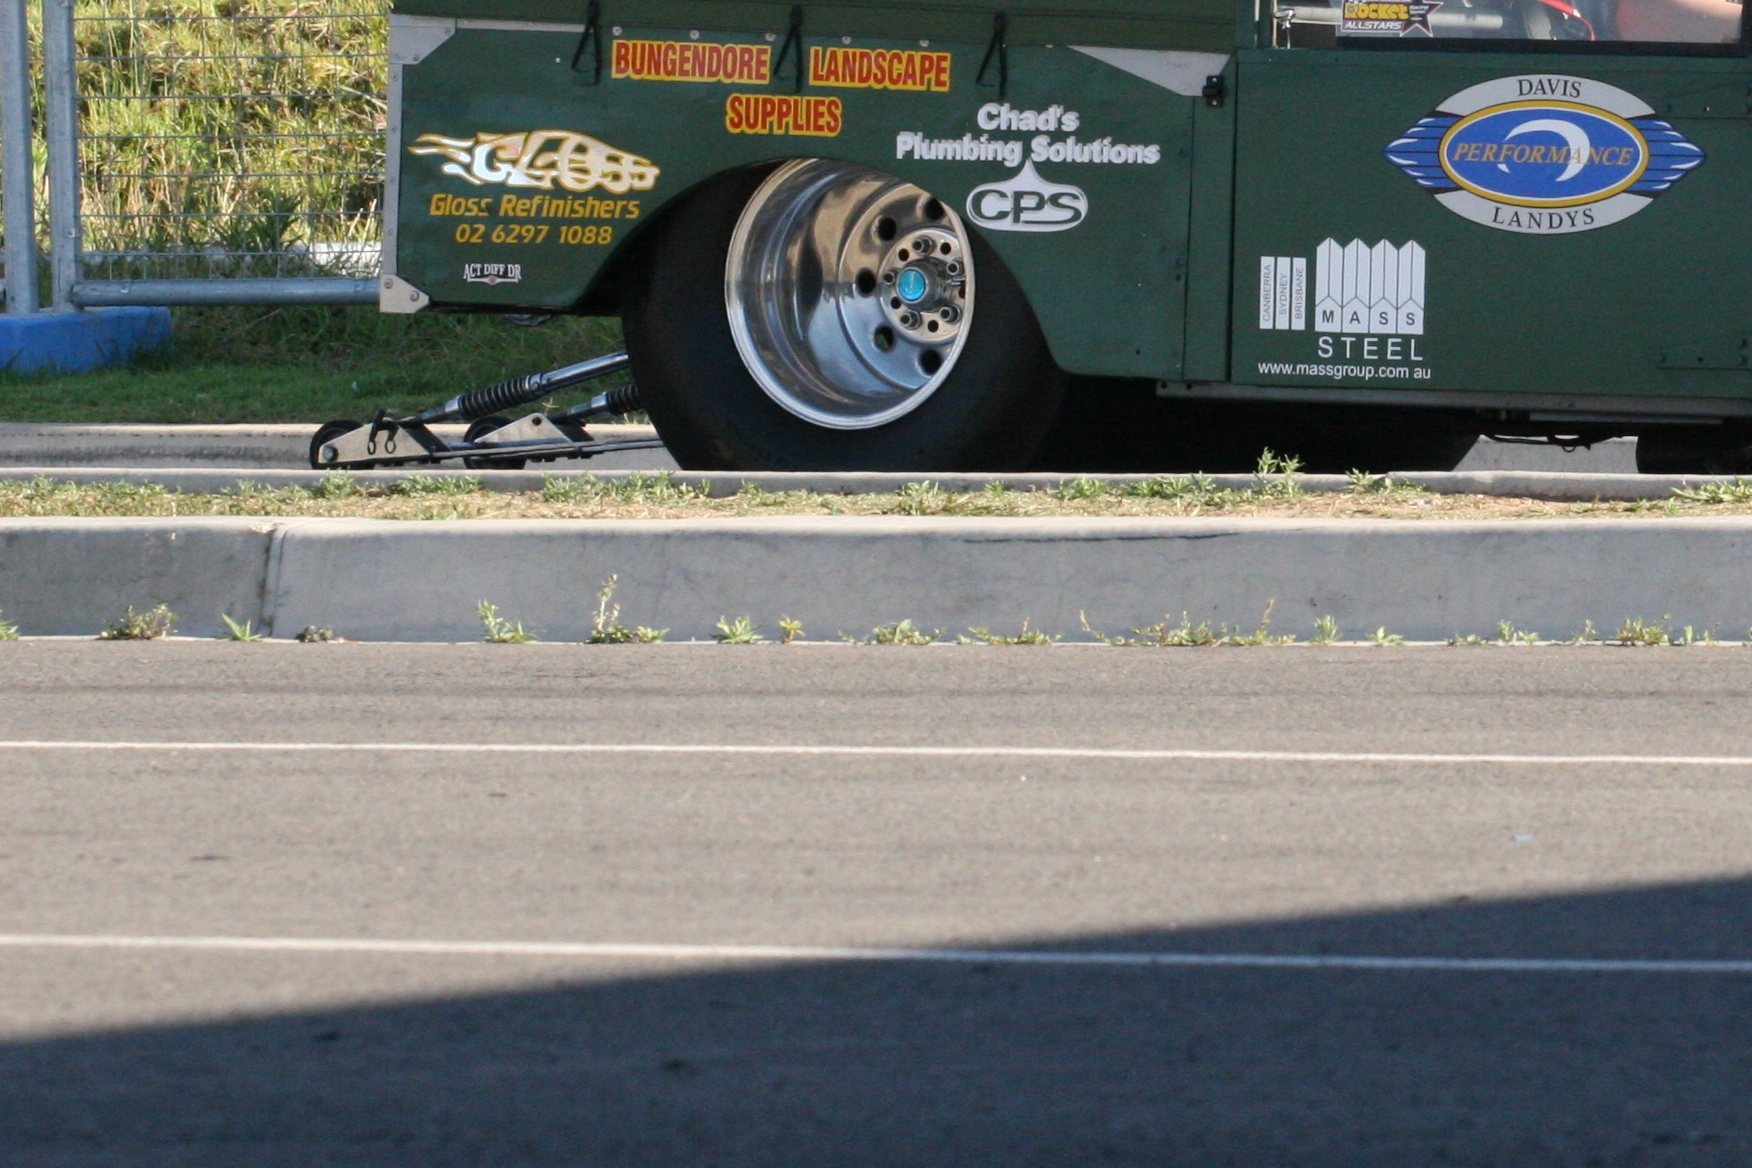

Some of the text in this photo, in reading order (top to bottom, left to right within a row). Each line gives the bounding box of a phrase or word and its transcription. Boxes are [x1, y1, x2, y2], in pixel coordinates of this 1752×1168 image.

[1344, 21, 1402, 30] ALLSTARS
[612, 40, 950, 91] BUNGENDORE LANDSCAPE
[1517, 78, 1583, 99] DAVIS
[726, 93, 841, 137] SUPPLIES
[977, 102, 1080, 132] Chad's
[896, 131, 1161, 168] Plumbing Solutions
[1453, 143, 1634, 167] PERFORMANCE
[430, 194, 641, 220] Gloss Refinishers
[969, 189, 1085, 224] CPS
[1491, 206, 1595, 230] LANDYS
[456, 224, 613, 245] 02 6297 1088
[463, 263, 482, 280] ACT
[484, 263, 506, 276] DIFF
[1262, 264, 1273, 322] CANBERRA
[1279, 272, 1289, 316] SYDNEY
[1294, 267, 1304, 320] BRISBANE
[1321, 310, 1416, 326] MASS
[1317, 336, 1424, 361] STEEL
[1258, 362, 1409, 380] www.massgroup.com
